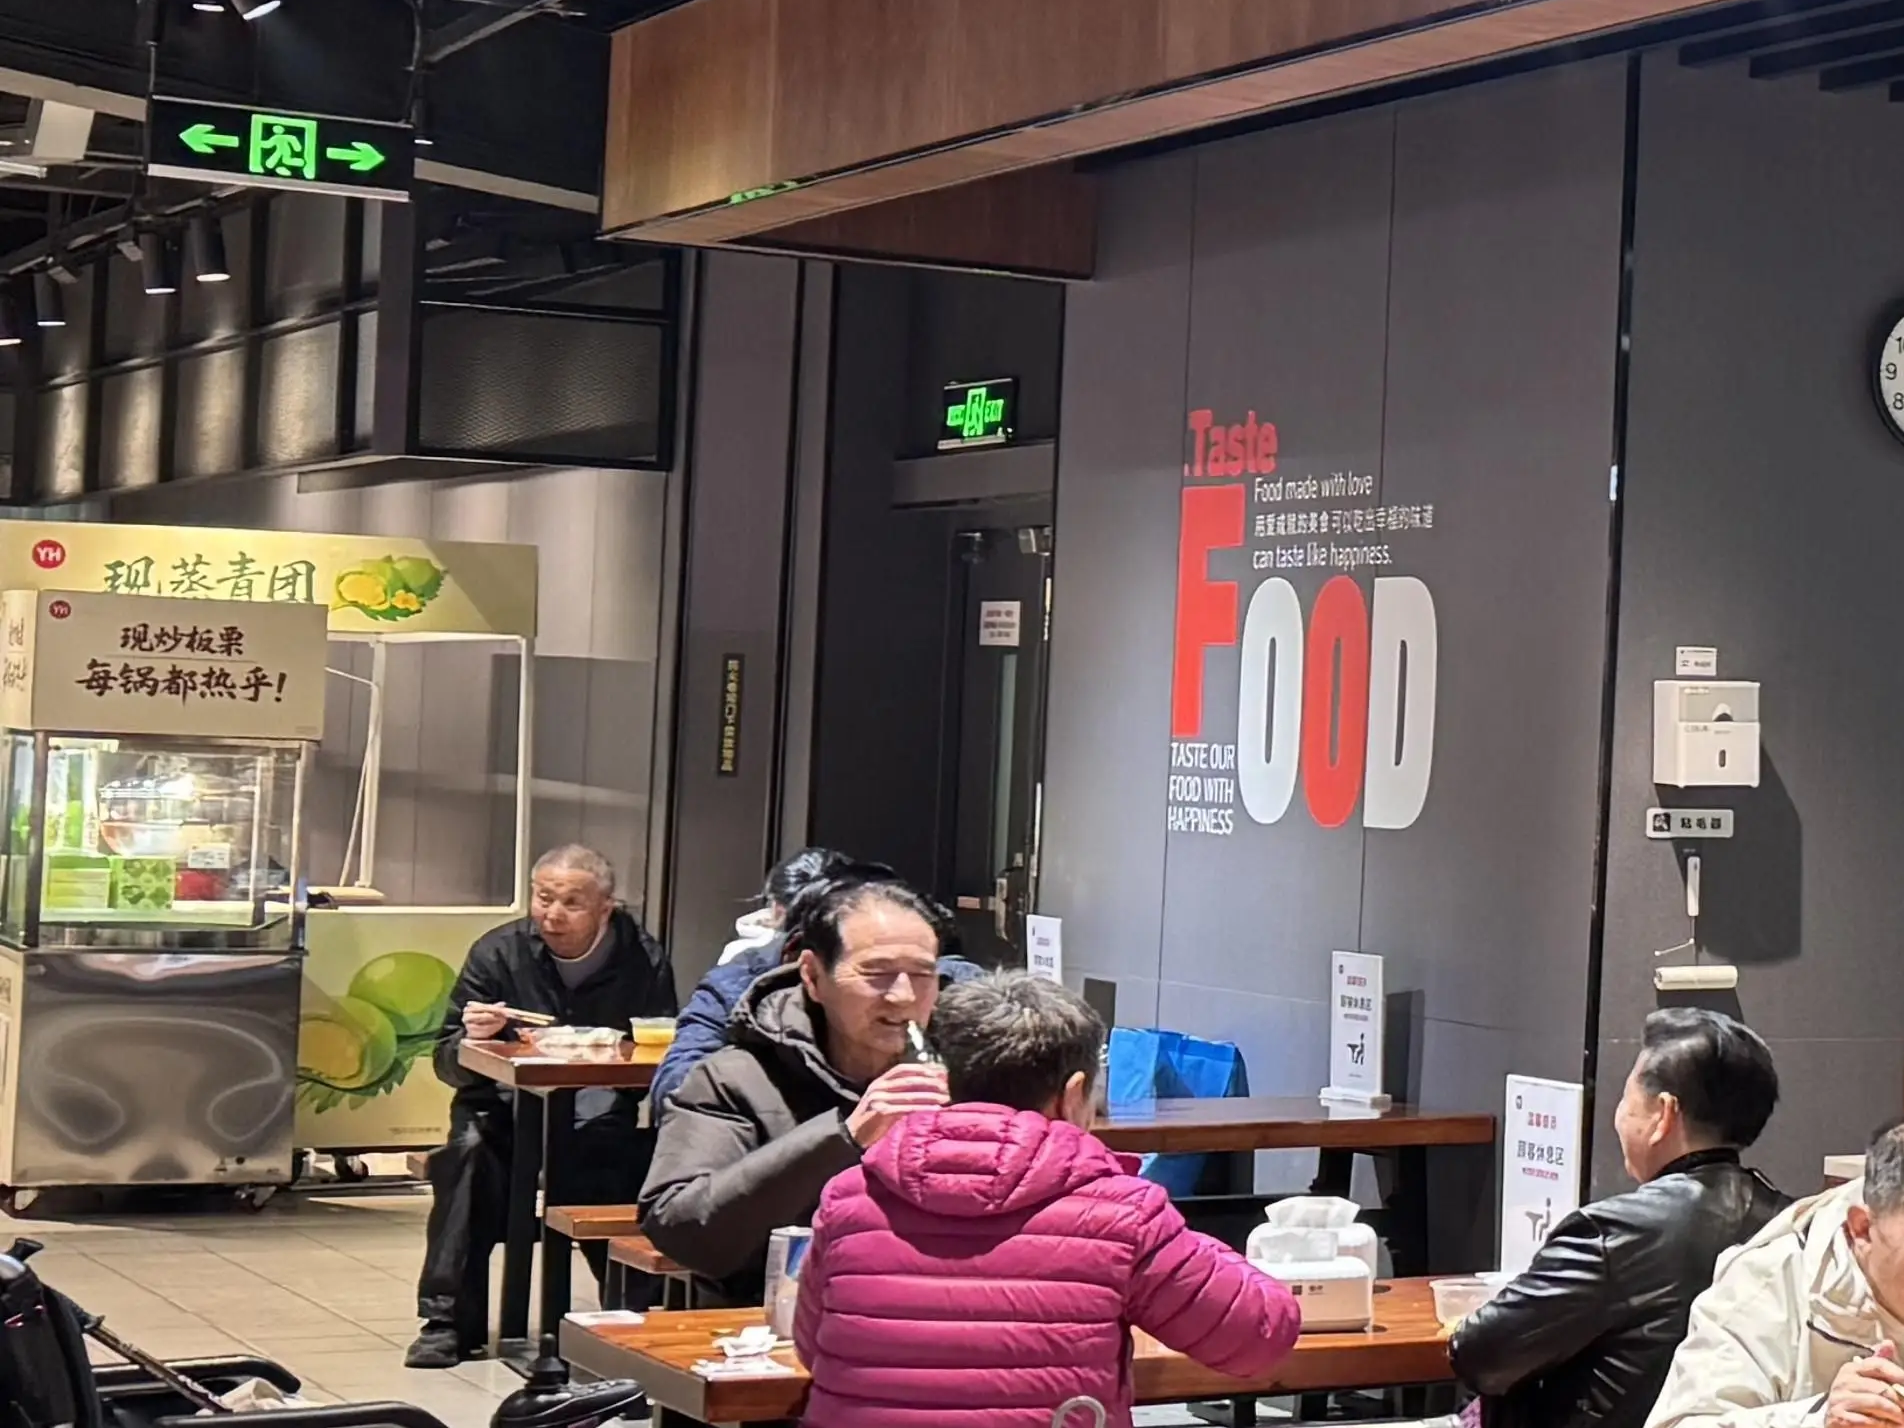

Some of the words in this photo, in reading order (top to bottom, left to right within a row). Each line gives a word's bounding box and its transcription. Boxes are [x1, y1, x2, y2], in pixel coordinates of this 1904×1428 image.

[1885, 363, 1897, 380] 9
[1892, 392, 1904, 410] 8
[1185, 410, 1278, 477] Taste
[1254, 476, 1283, 503] Food
[1285, 474, 1318, 500] made
[1320, 472, 1346, 498] with
[1348, 470, 1373, 496] love
[37, 546, 62, 562] YH
[1252, 549, 1274, 570] can
[1276, 544, 1304, 568] taste
[1306, 542, 1327, 567] like
[1329, 541, 1392, 571] happiness.
[103, 551, 317, 606] 现蒸青团
[120, 623, 245, 657] 现炒板栗
[1172, 483, 1437, 829] FOOD
[1171, 742, 1209, 769] TASTE
[1210, 743, 1235, 770] OUR
[1168, 775, 1201, 802] FOOD
[1203, 777, 1235, 804] WITH
[1167, 805, 1234, 835] HAPPINESS
